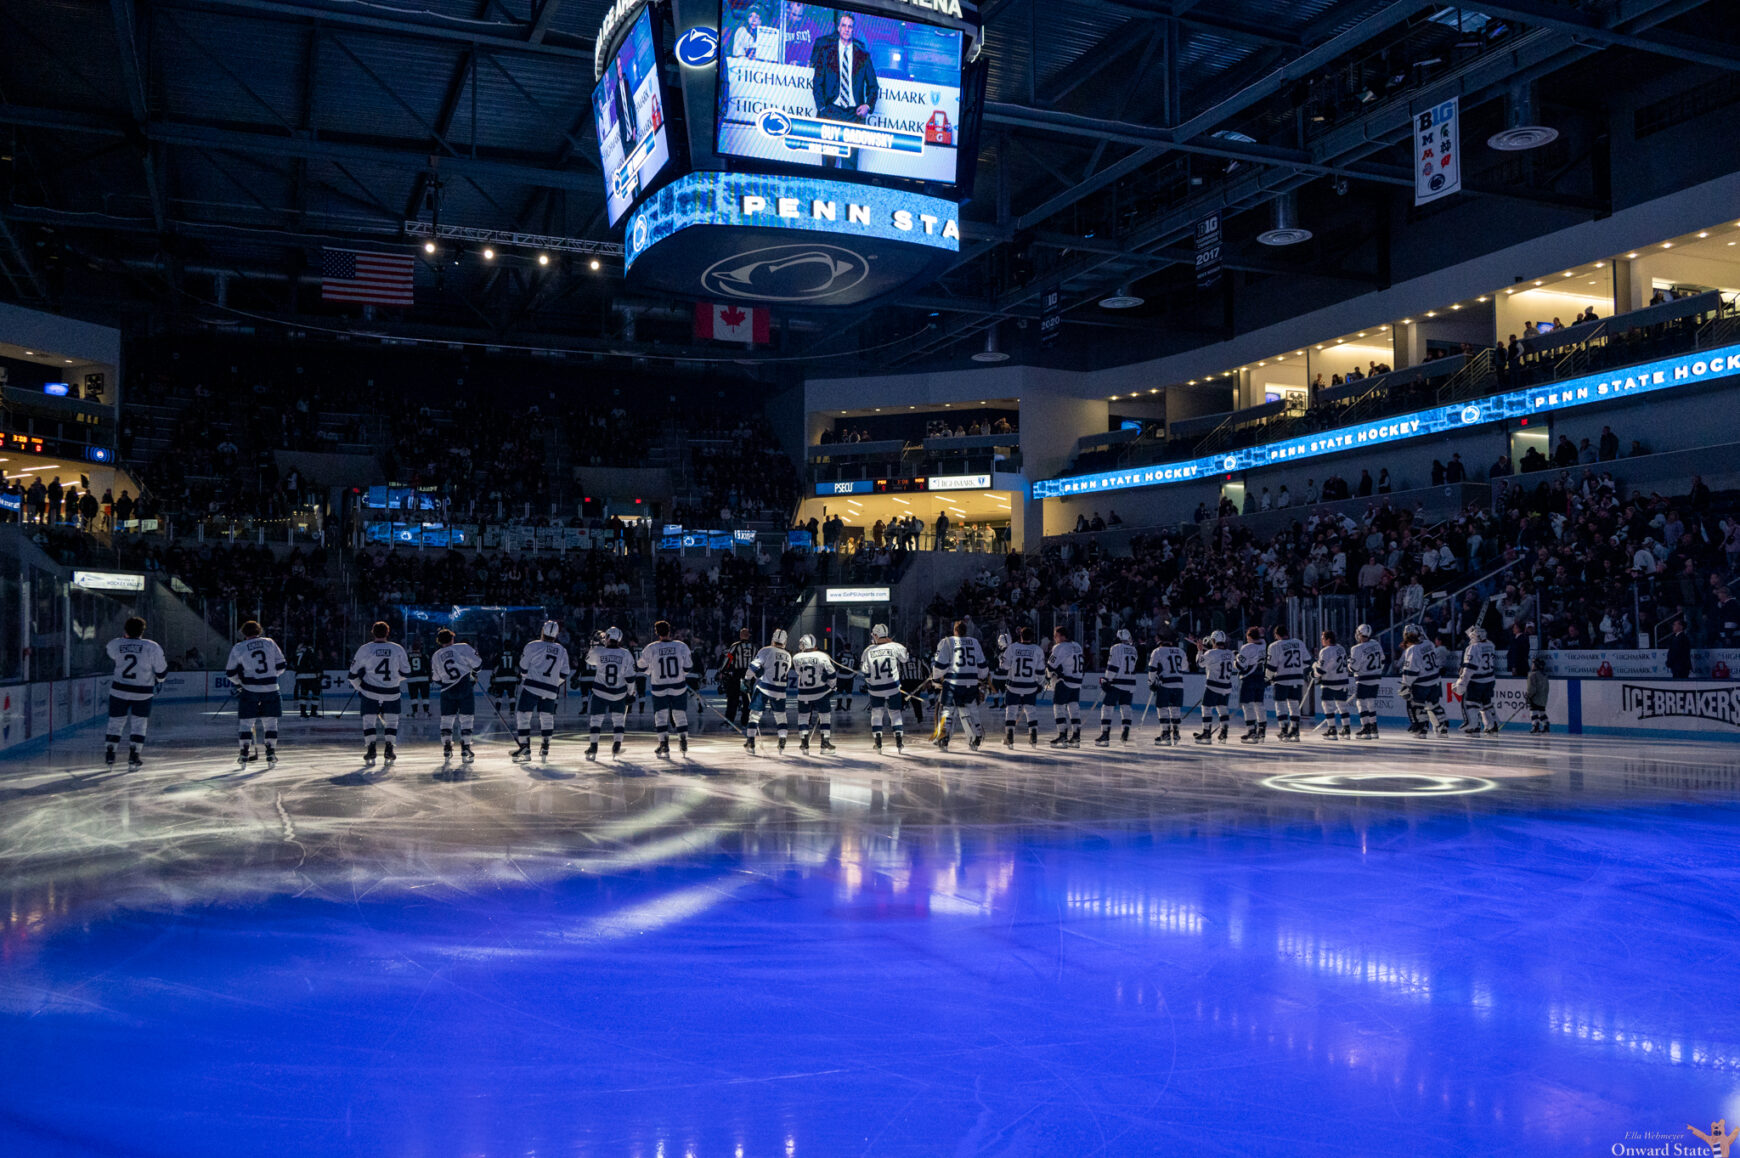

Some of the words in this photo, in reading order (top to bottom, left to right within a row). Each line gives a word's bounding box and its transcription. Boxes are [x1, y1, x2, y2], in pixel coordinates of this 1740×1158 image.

[738, 68, 813, 90] HIGHMARK
[878, 87, 926, 105] HMARK
[736, 99, 813, 118] HIGARK
[867, 115, 925, 133] GHMARK
[743, 195, 871, 226] PENN
[893, 209, 960, 240] STA
[1196, 247, 1220, 265] 2017
[1535, 387, 1588, 408] PENN
[1597, 371, 1665, 394] STATE
[1674, 354, 1740, 380] HOCK
[1270, 444, 1306, 460] PENN
[1311, 435, 1353, 452] STATE
[1357, 420, 1420, 442] HOCKEY
[834, 482, 854, 493] PSECU
[1064, 481, 1097, 492] PENN
[1101, 475, 1140, 487] STATE
[1145, 466, 1198, 481] HOCKEY
[122, 654, 137, 679] 2
[251, 650, 268, 674] 3
[501, 655, 513, 669] 11
[542, 654, 557, 677] 7
[658, 656, 679, 679] 10
[954, 646, 976, 667] 35
[1014, 657, 1034, 678] 15
[1284, 650, 1301, 668] 23
[1367, 652, 1381, 671] 27
[375, 658, 391, 681] 4
[444, 659, 461, 680] 6
[605, 663, 618, 686] 8
[772, 660, 788, 683] 12
[872, 658, 893, 680] 14
[1219, 661, 1232, 680] 19
